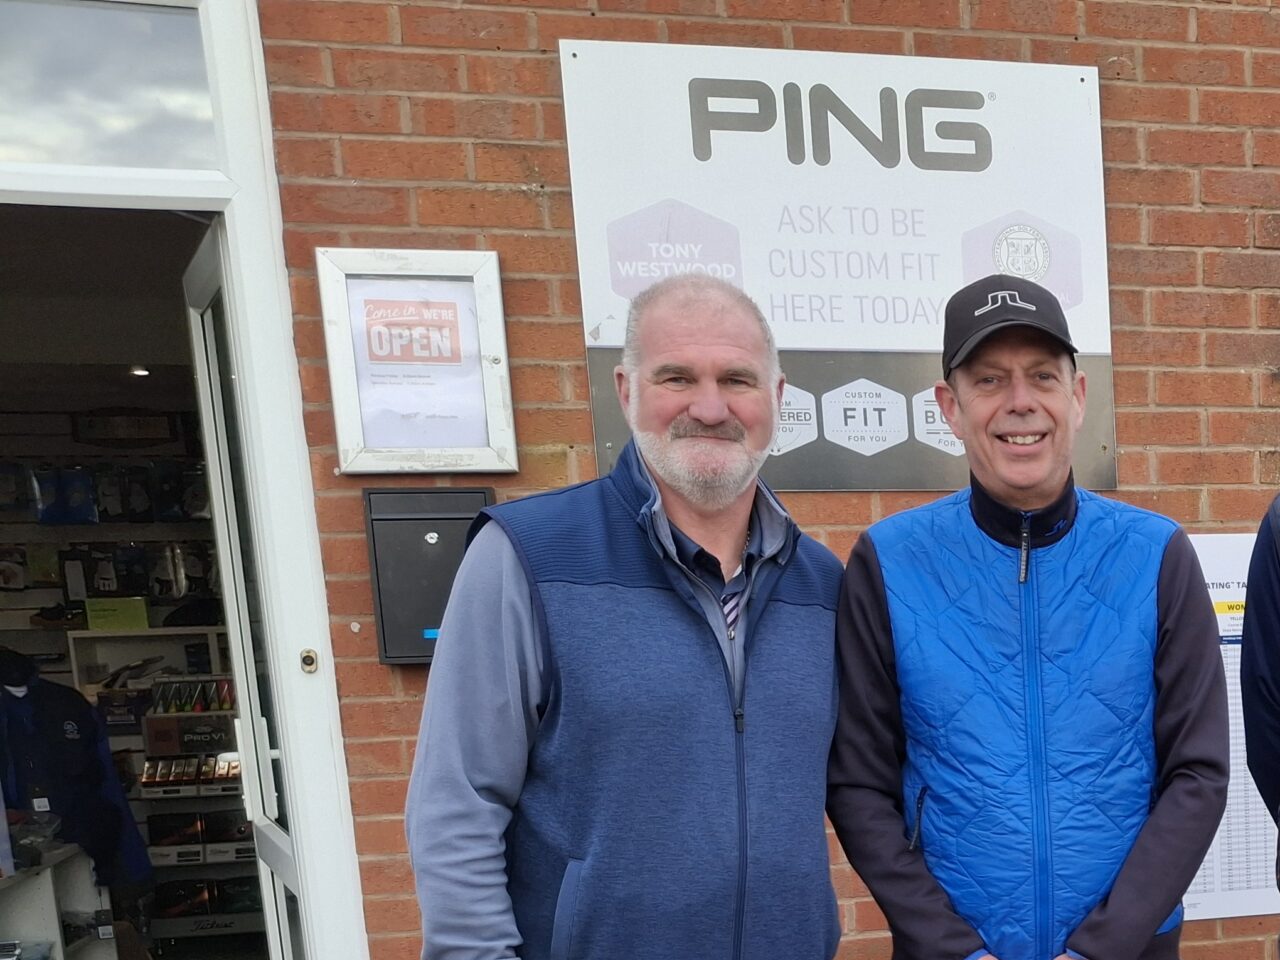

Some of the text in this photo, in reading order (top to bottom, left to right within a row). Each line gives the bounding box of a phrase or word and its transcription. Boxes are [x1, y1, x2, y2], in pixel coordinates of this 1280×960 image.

[778, 204, 927, 238] ASK TO BE
[648, 242, 703, 259] TONY
[768, 248, 941, 282] CUSTOM FIT
[422, 308, 455, 320] WE'RE
[769, 293, 946, 325] HERE TODAY
[370, 325, 453, 357] OPEN
[844, 391, 882, 399] CUSTOM
[842, 407, 887, 427] FIT
[938, 438, 956, 447] FOR
